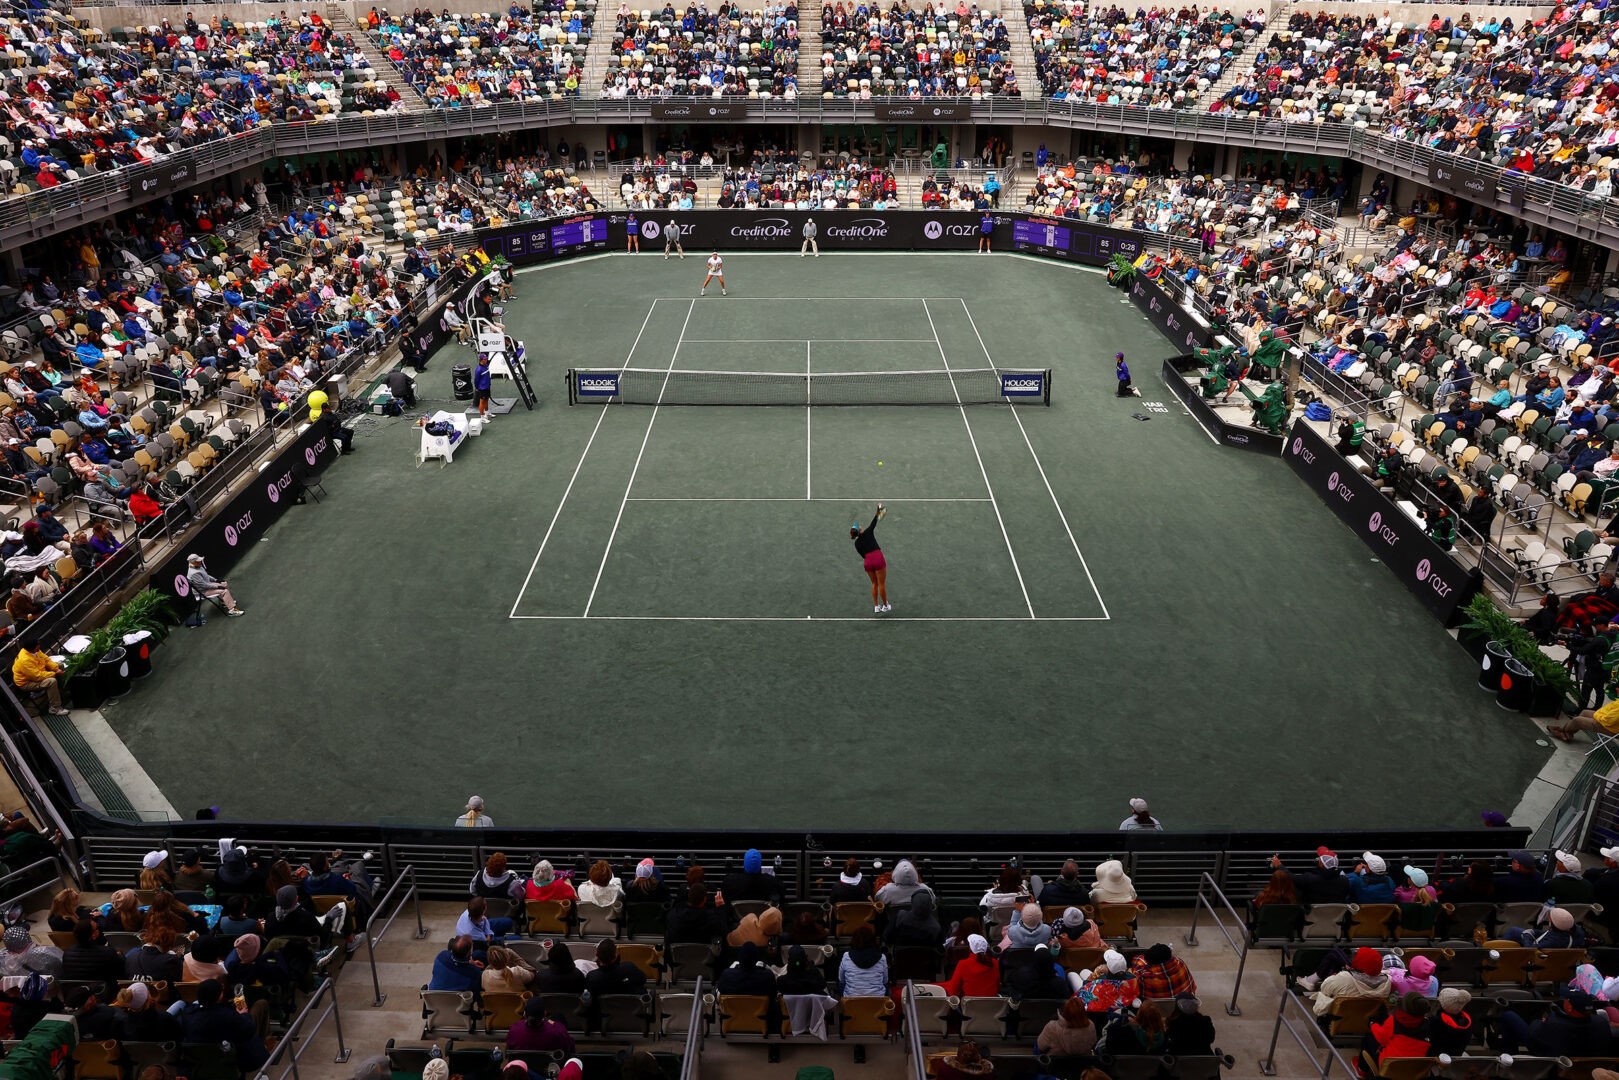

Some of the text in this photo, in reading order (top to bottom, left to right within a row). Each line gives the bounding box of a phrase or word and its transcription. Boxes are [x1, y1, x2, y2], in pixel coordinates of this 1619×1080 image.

[531, 232, 546, 241] 0:28
[731, 225, 791, 237] CreditOne
[827, 225, 887, 237] CreditOne
[946, 225, 979, 236] razr
[512, 237, 521, 245] 85
[1100, 239, 1109, 247] 85
[1120, 242, 1136, 251] 0:28
[1004, 379, 1039, 387] HOLOGIC
[313, 436, 327, 456] razr
[1300, 447, 1316, 464] razr
[277, 470, 292, 492] razr
[1336, 483, 1355, 502] razr
[236, 510, 253, 534] razr
[1379, 524, 1400, 546] razr
[1428, 573, 1452, 598] razr
